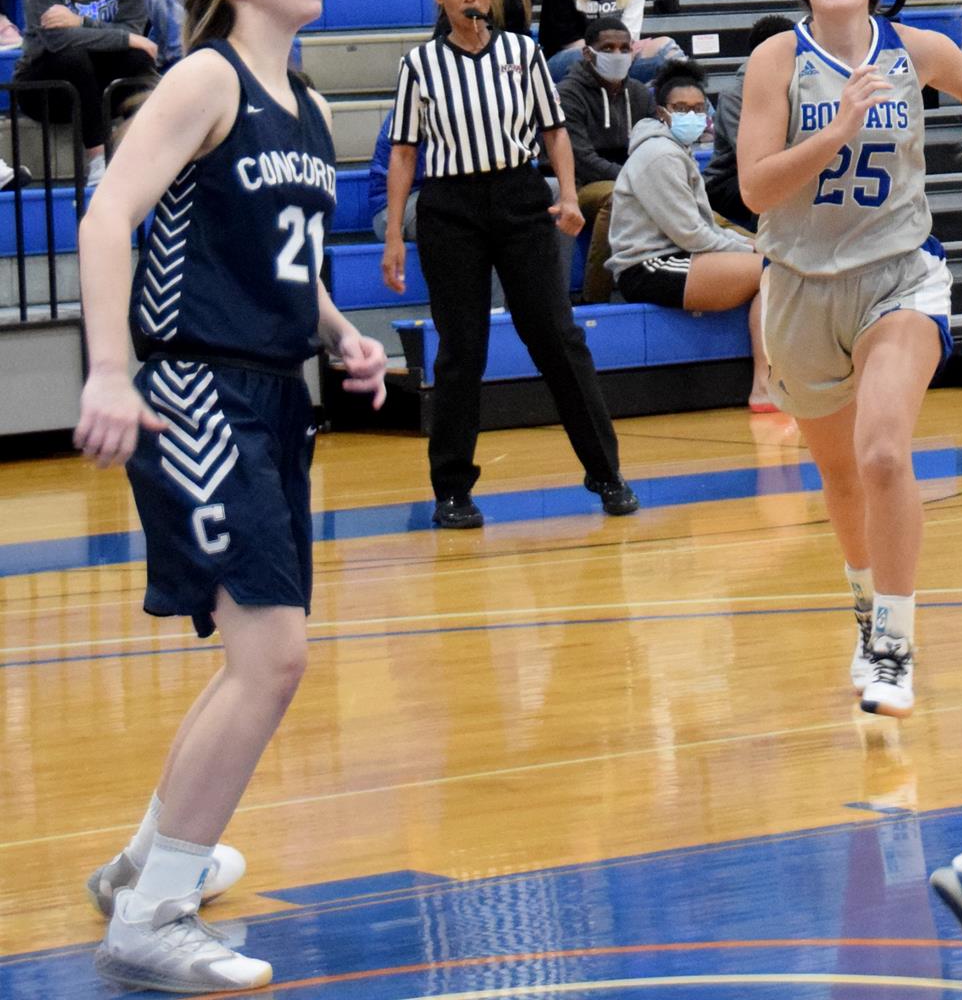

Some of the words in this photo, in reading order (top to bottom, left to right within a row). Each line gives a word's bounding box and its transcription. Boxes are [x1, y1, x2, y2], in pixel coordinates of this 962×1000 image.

[801, 100, 908, 131] BOATS
[813, 142, 896, 208] 25
[276, 204, 325, 283] 21
[191, 503, 230, 554] C
